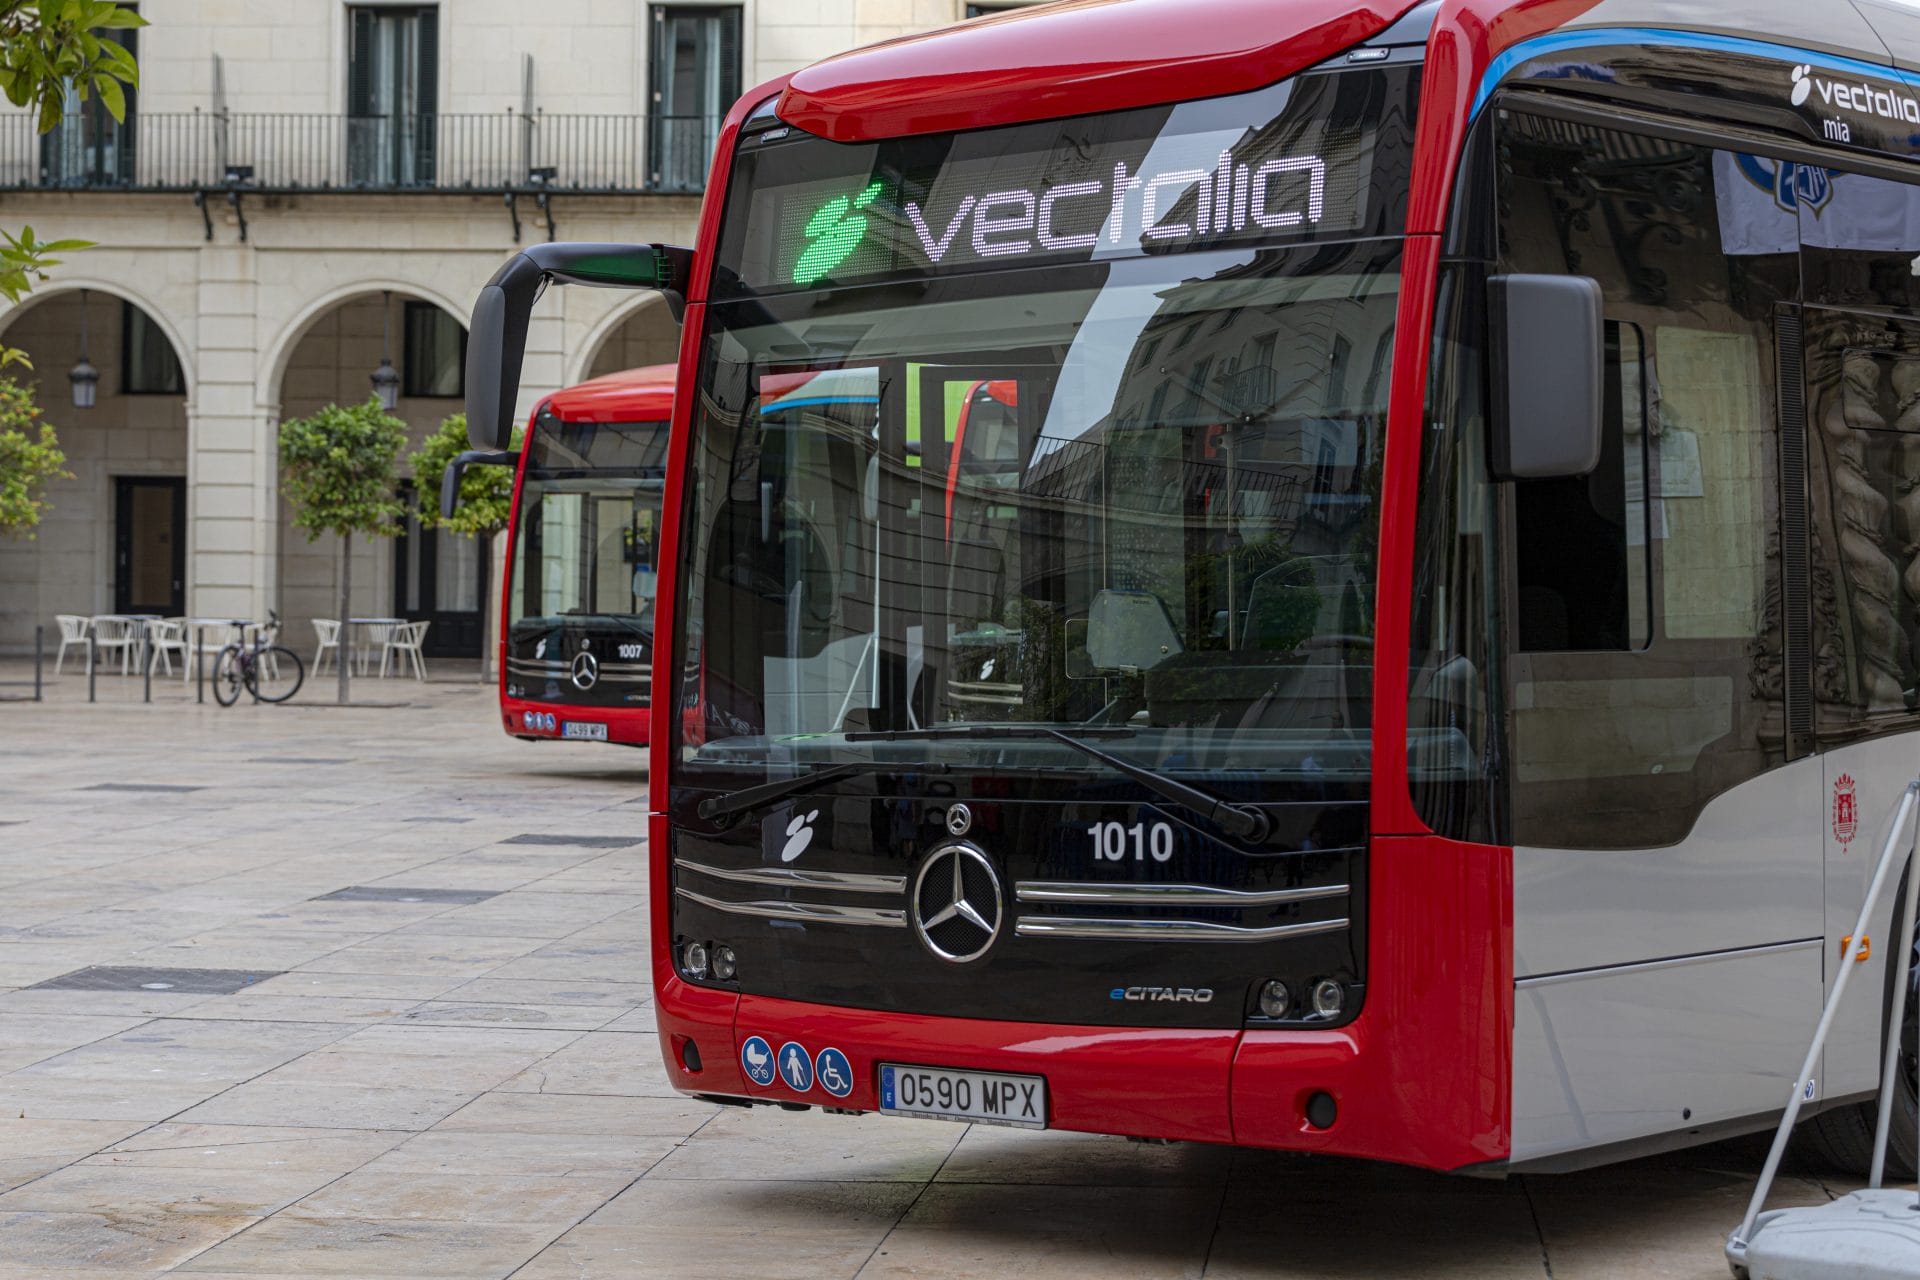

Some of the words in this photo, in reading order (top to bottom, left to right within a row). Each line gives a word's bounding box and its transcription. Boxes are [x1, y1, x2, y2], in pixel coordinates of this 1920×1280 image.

[1815, 78, 1920, 124] vectalia
[1823, 115, 1850, 142] mia
[903, 148, 1326, 263] vectalia
[618, 643, 643, 658] 1007
[1087, 821, 1174, 862] 1010
[1109, 987, 1214, 1003] eCITARO
[886, 1091, 892, 1102] E
[901, 1073, 971, 1111] 0590
[982, 1080, 1037, 1118] MPX
